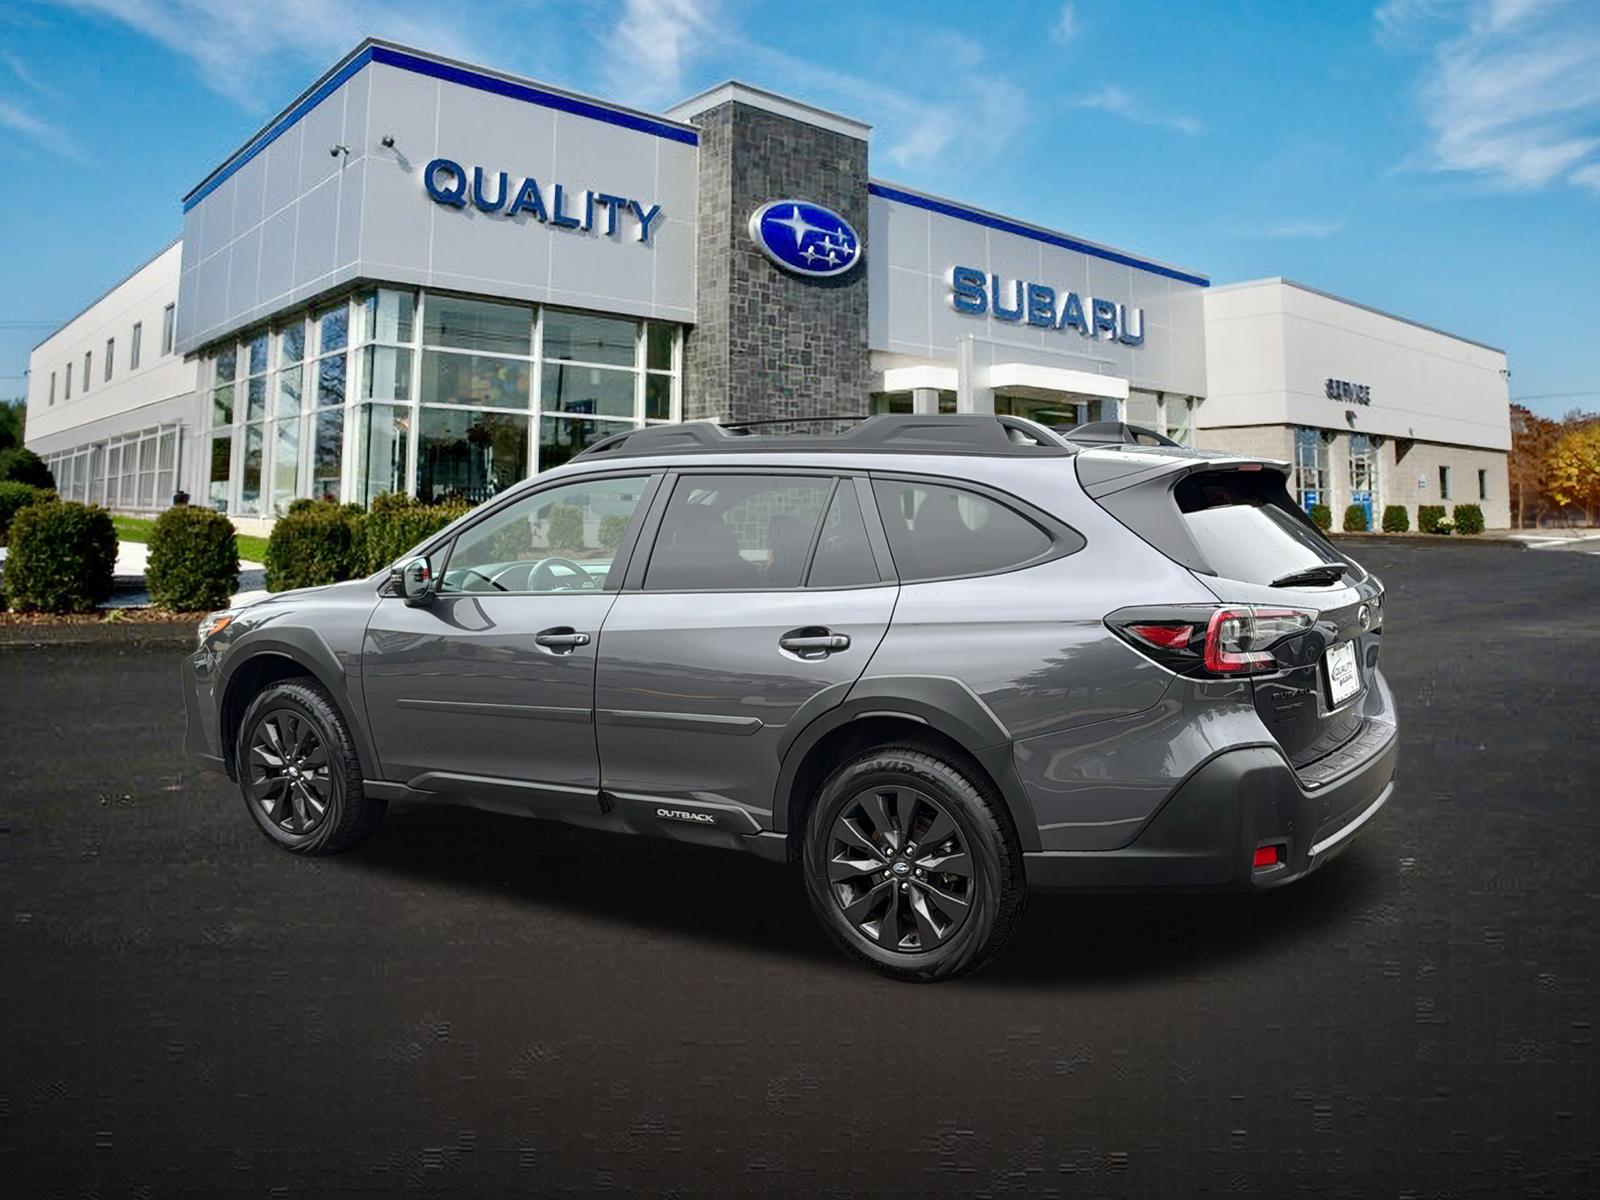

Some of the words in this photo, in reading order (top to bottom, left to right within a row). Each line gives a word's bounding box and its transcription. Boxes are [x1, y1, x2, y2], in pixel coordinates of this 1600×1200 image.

[424, 159, 661, 243] QUALITY
[951, 265, 1144, 346] SUBARU
[656, 808, 715, 823] OUTBACK
